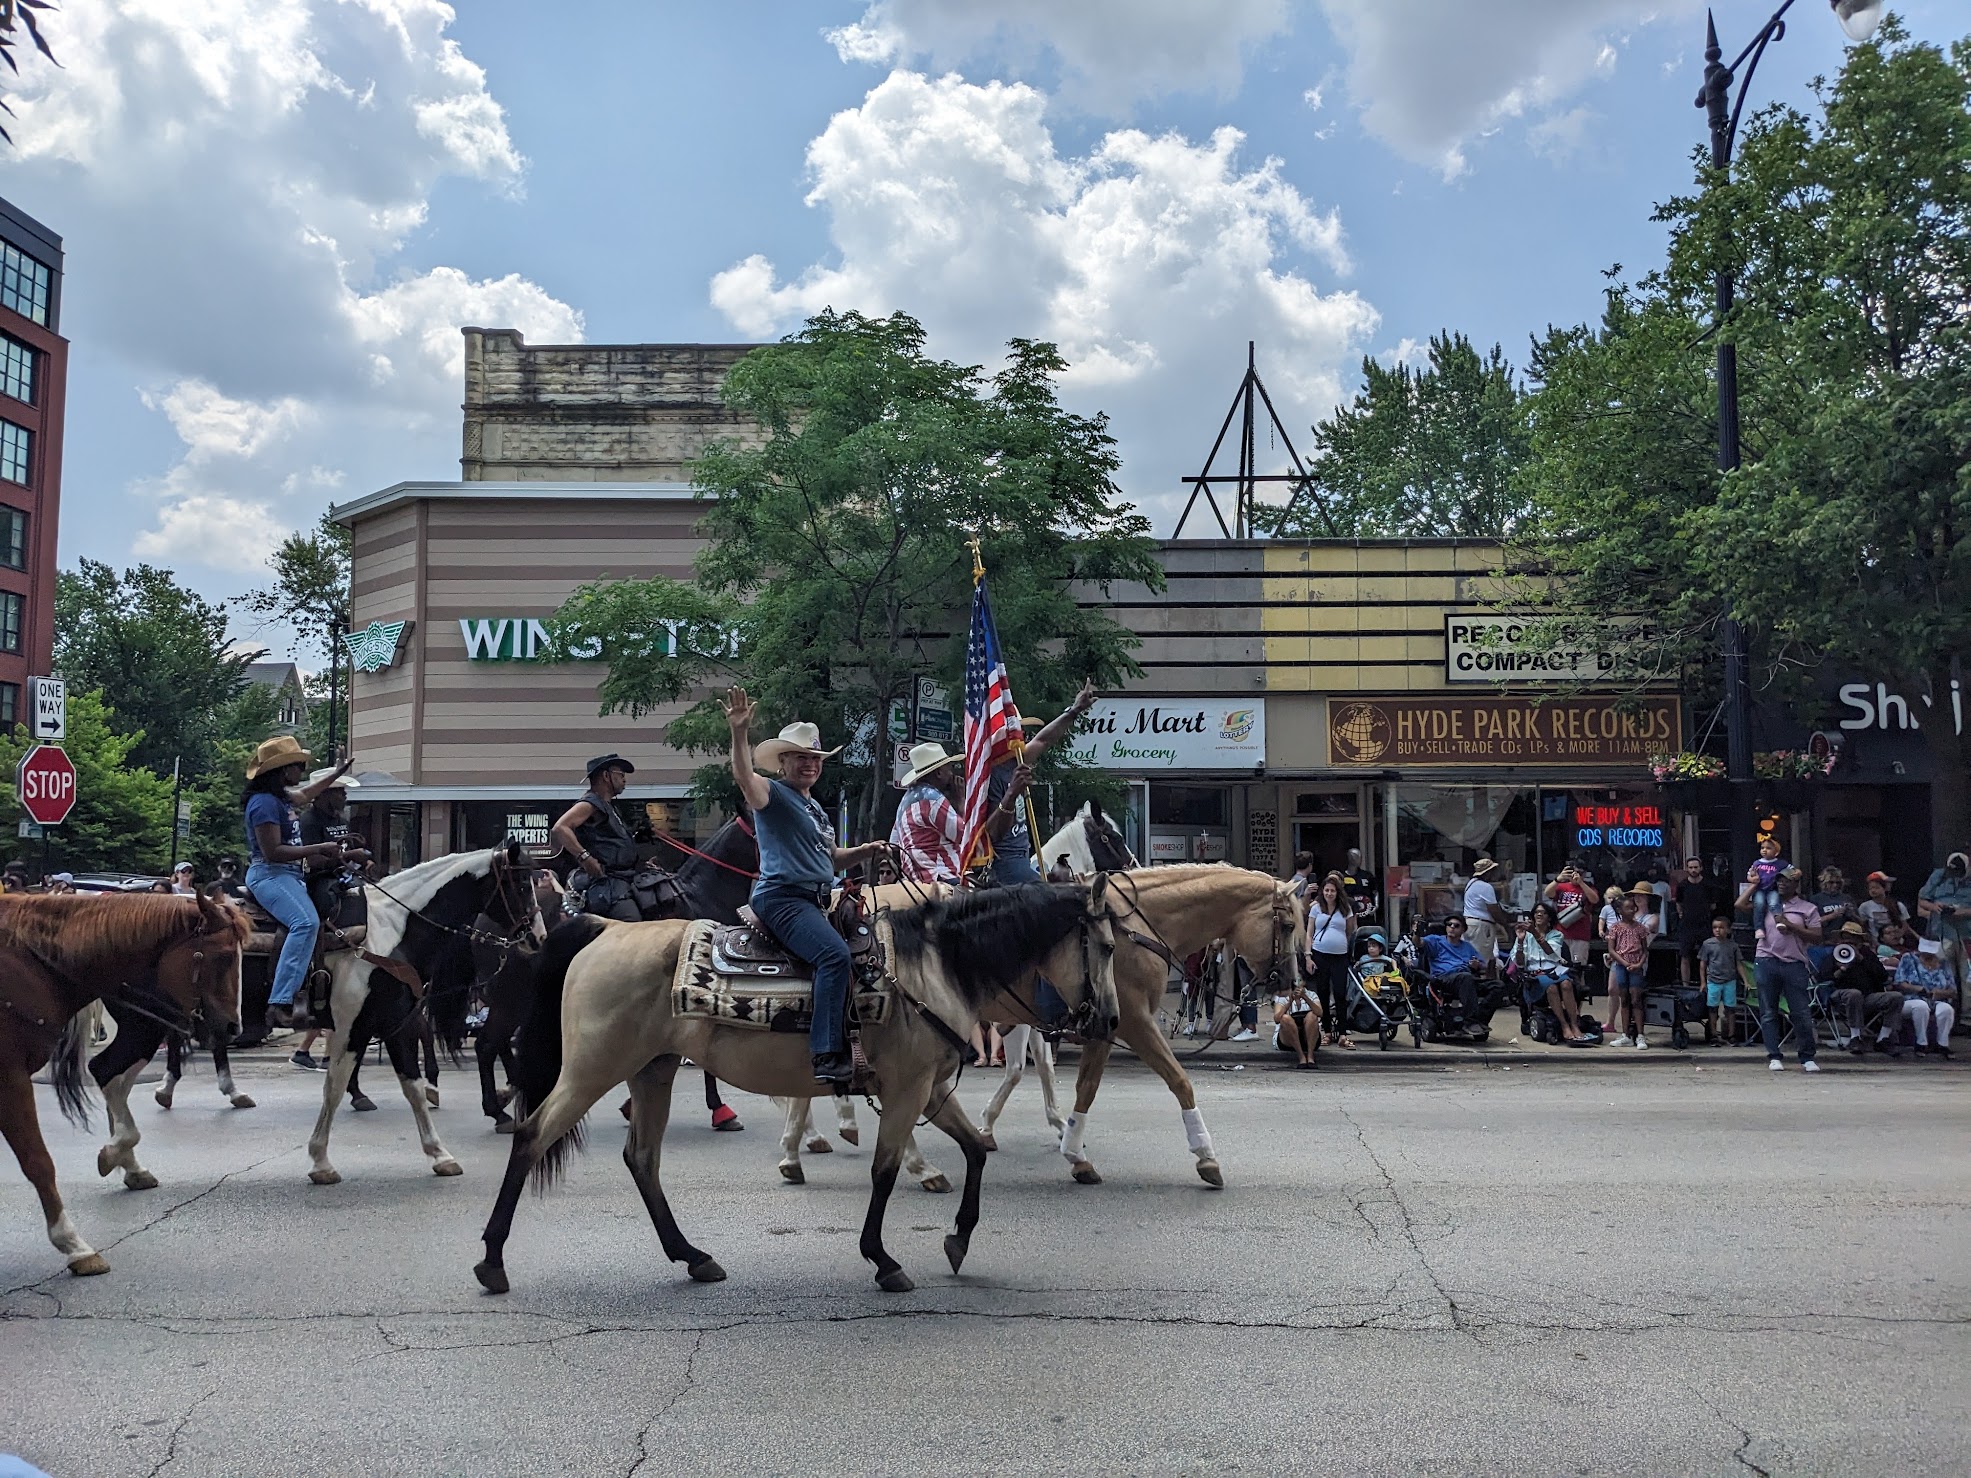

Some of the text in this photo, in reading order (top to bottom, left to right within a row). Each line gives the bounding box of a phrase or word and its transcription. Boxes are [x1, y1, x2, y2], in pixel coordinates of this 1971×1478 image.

[1457, 652, 1582, 671] COMPACT
[39, 683, 62, 698] ONE
[39, 699, 62, 715] WAY
[1079, 707, 1207, 734] ini Mart
[1220, 720, 1255, 739] LOTTERY
[1397, 707, 1671, 740] HYDE PARK RECORDS
[1064, 739, 1178, 766] ood Grocery
[1500, 740, 1522, 754] CDs
[1530, 740, 1550, 754] LPs
[1557, 741, 1565, 754] &
[1568, 740, 1600, 754] MORE
[25, 769, 73, 800] STOP
[506, 813, 549, 828] THE WING
[1576, 807, 1663, 825] WE BUY & SELL
[507, 828, 549, 844] EXPERTS
[1251, 828, 1276, 836] HYDE
[1578, 828, 1663, 847] CDS RECORDS
